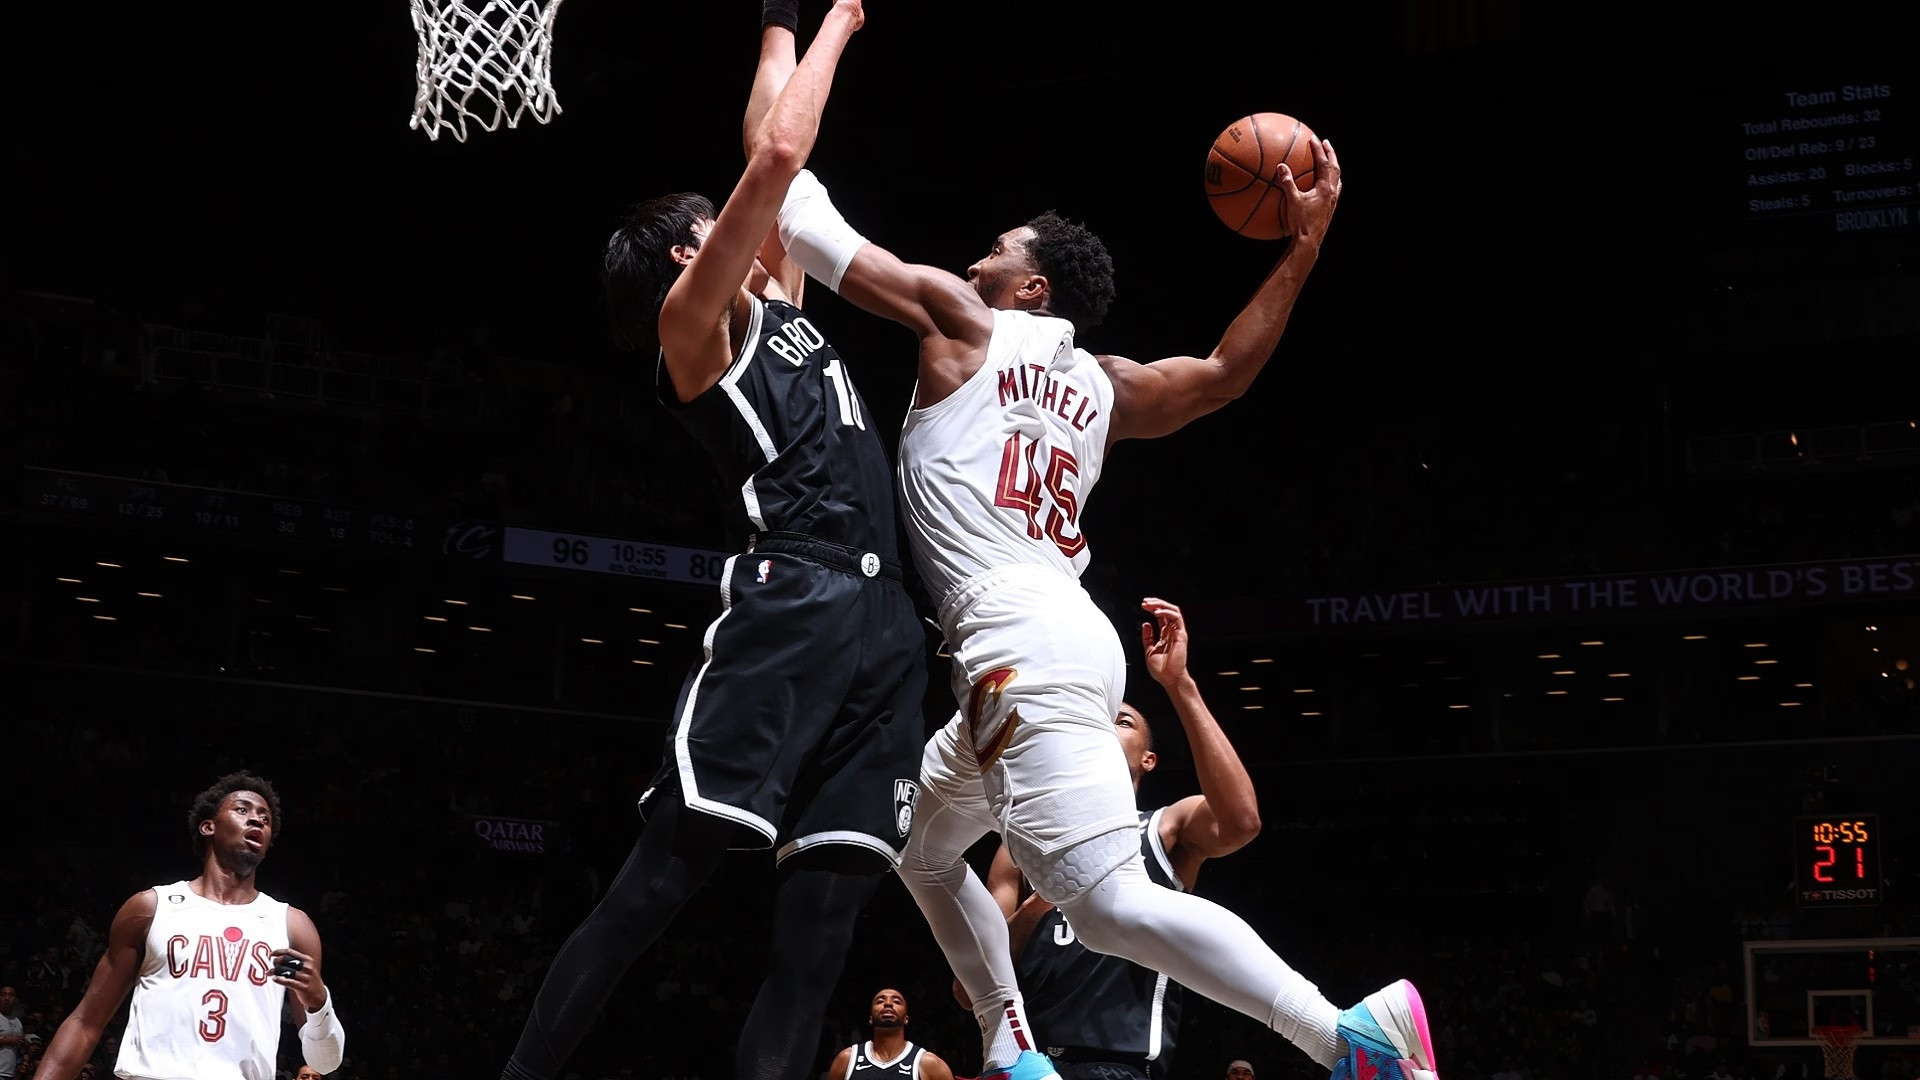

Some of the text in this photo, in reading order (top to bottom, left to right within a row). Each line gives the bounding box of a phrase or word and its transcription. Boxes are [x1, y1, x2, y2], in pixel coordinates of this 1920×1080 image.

[1784, 83, 1892, 107] Team Stats
[1742, 109, 1882, 136] Total Rebounds: 32
[1745, 143, 1795, 161] Off/Def
[1799, 140, 1833, 156] Reb:
[1747, 167, 1827, 187] Assists: 20
[1844, 157, 1913, 176] Blocks: 5
[1749, 194, 1811, 212] Steals: 5
[1833, 184, 1912, 203] Turnovers:
[1836, 206, 1909, 232] BROOKLYN
[766, 316, 827, 368] BRO
[997, 362, 1098, 432] MITHEL
[994, 429, 1087, 559] 45
[552, 537, 589, 566] 96
[611, 543, 666, 567] 10:55
[628, 565, 667, 578] Quarter
[690, 553, 724, 581] 80
[1306, 592, 1441, 625] TRAVEL
[1452, 583, 1551, 617] WITH
[1563, 578, 1640, 611] THE
[1650, 566, 1829, 605] WORLD'S
[474, 820, 544, 841] QATAR
[1813, 821, 1868, 844] 10:55
[489, 839, 545, 854] AIRWAYS
[1813, 845, 1864, 882] 21
[1822, 888, 1877, 900] TISSOT
[167, 934, 272, 987] CAVS
[199, 988, 229, 1043] 3
